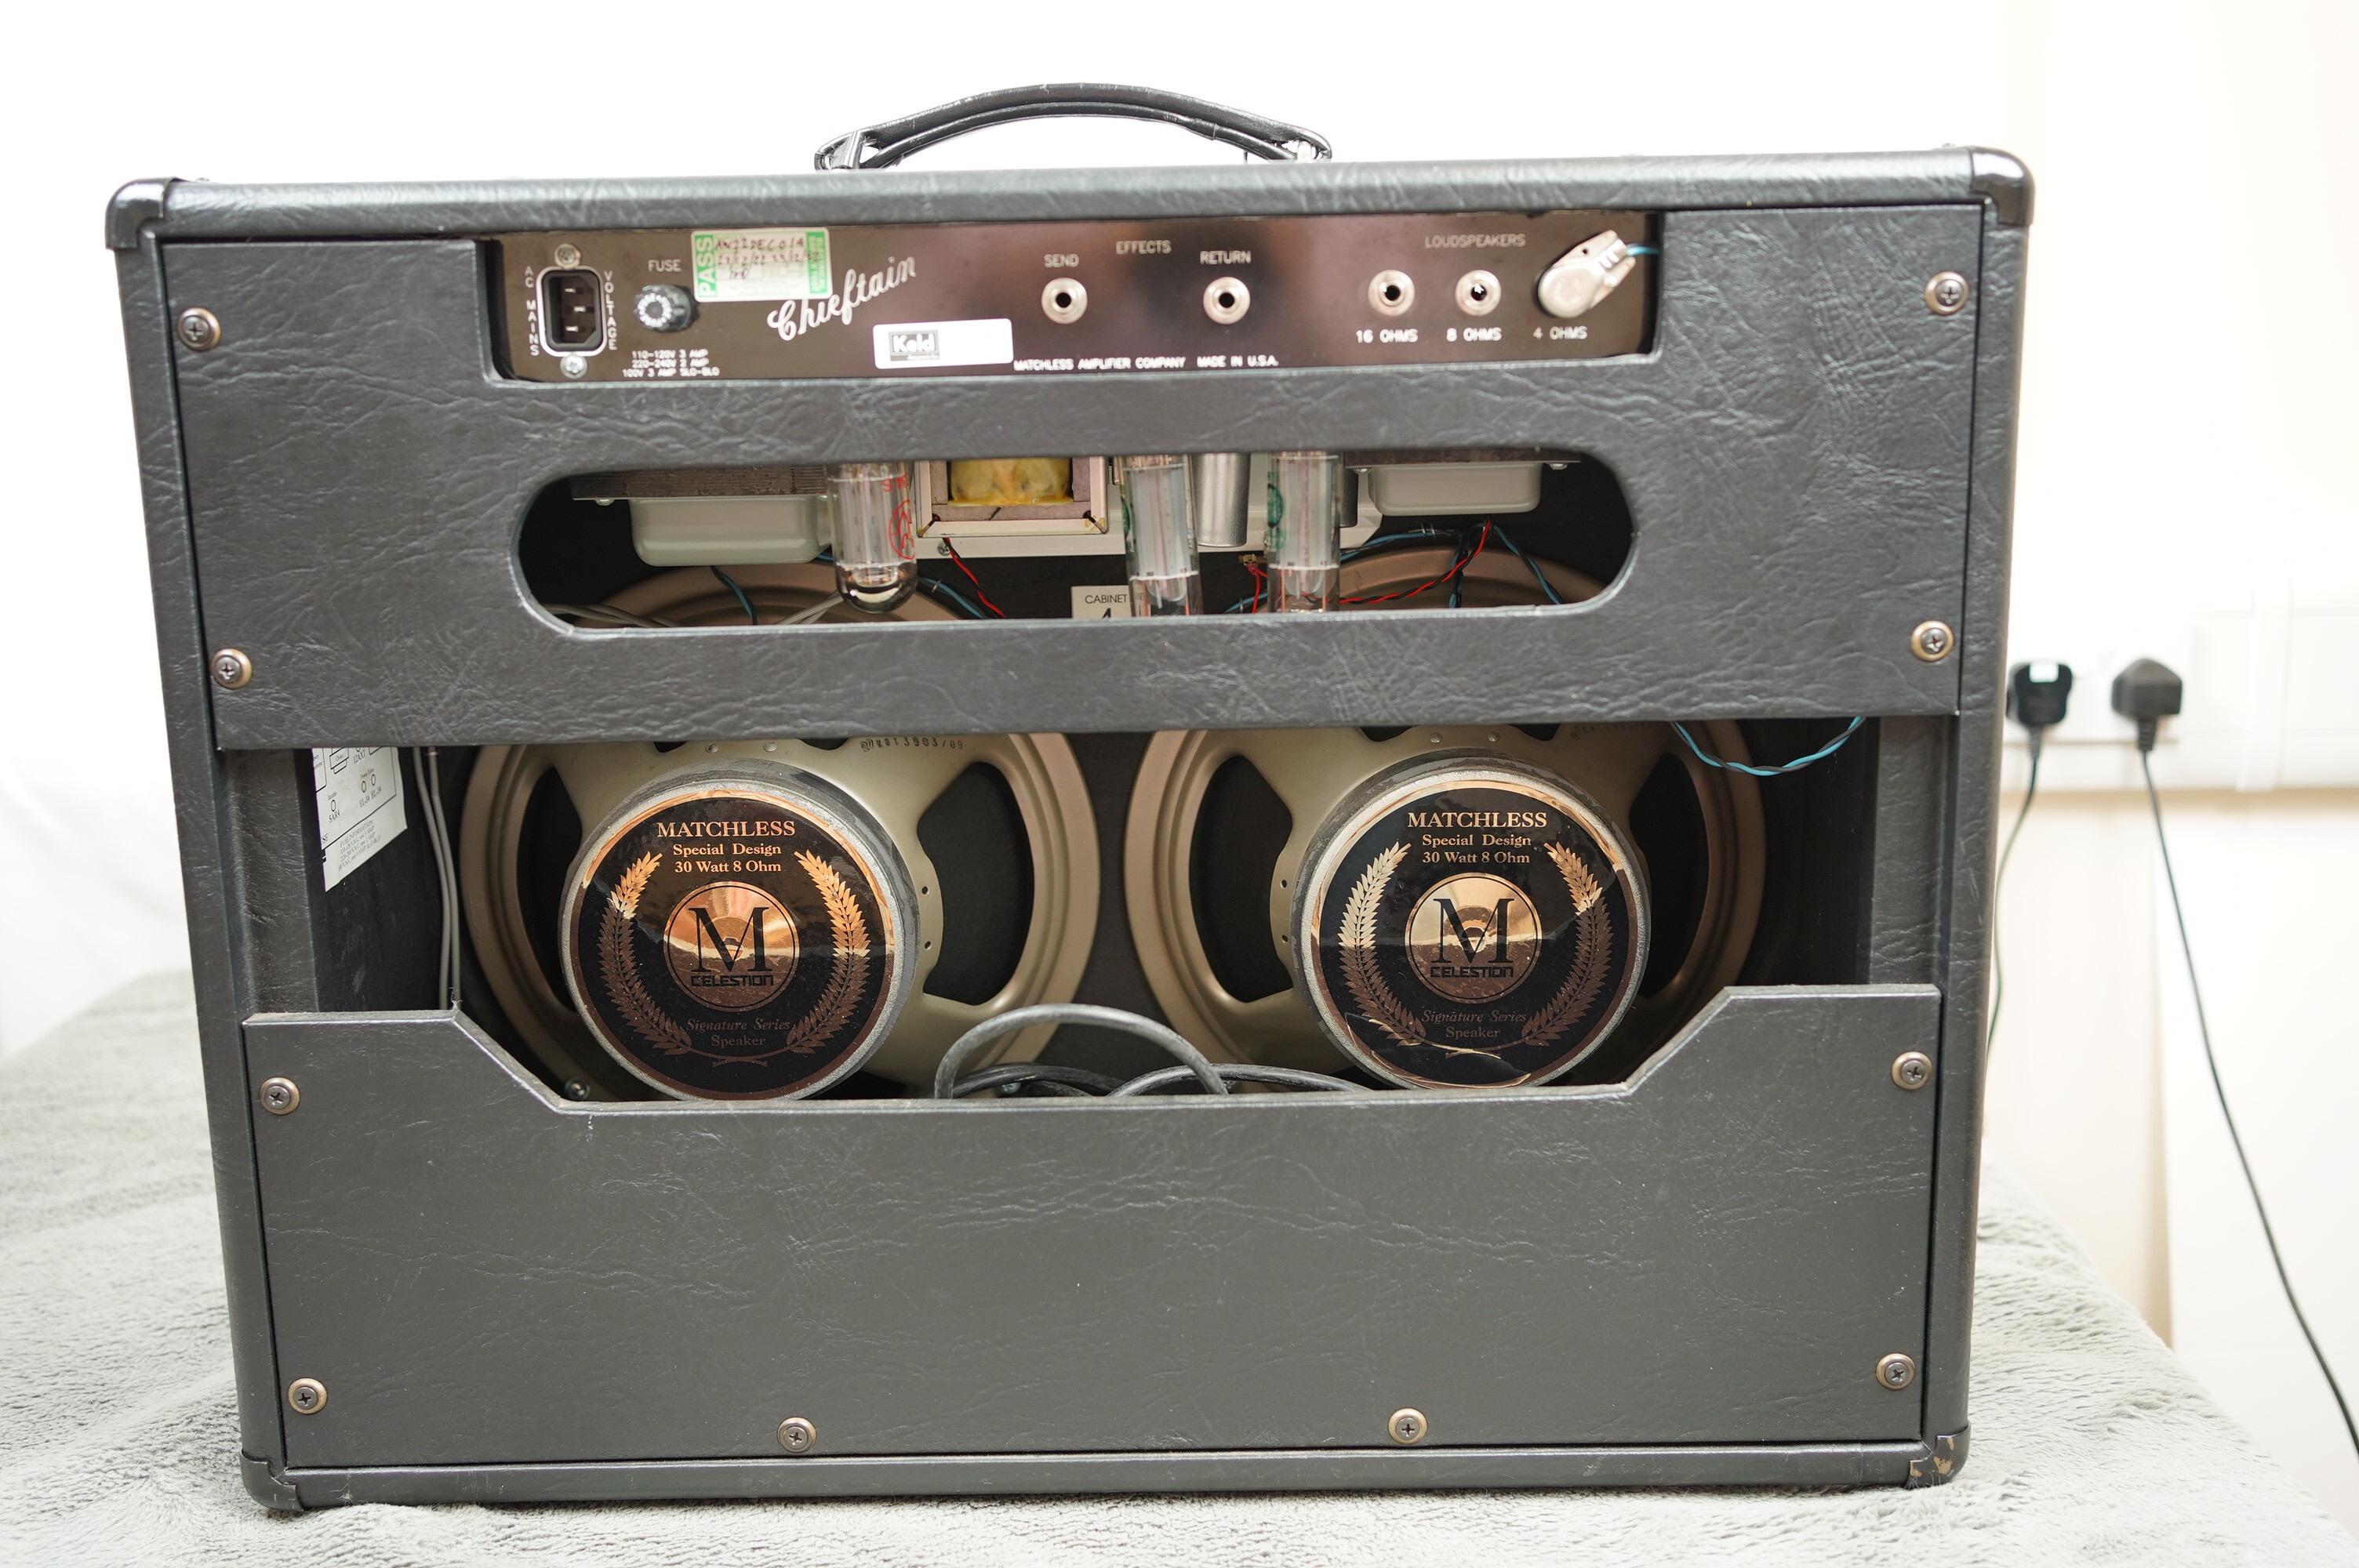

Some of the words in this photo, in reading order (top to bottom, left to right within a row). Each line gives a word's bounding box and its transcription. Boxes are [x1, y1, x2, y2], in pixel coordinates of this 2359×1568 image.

[1116, 240, 1172, 255] EFFECTS
[1425, 234, 1526, 249] LOUDSPEAKERS
[1044, 254, 1079, 267] SEND
[1200, 250, 1251, 264] RETURN
[648, 260, 682, 273] FUSE
[696, 237, 716, 296] PASS
[525, 266, 534, 289] AC
[767, 256, 916, 341] Chieftain
[603, 270, 618, 350] VOLTAGE
[525, 299, 540, 356] MAINS
[1446, 328, 1457, 341] 8
[1463, 327, 1502, 341] OHMS
[1532, 327, 1543, 339] 4
[1550, 326, 1587, 340] OHMS
[1356, 329, 1373, 343] 16
[1379, 328, 1418, 343] OHMS
[689, 349, 709, 358] AMP
[690, 358, 710, 367] AMP
[1014, 359, 1074, 371] MATCHLESS
[1078, 358, 1131, 370] AMPLIFIER
[1136, 357, 1186, 369] COMPANY
[1198, 356, 1226, 367] MADE
[1231, 355, 1243, 367] IN
[1248, 355, 1279, 366] U.S.A.
[657, 368, 677, 376] AMP
[1085, 594, 1128, 604] CABINET
[1408, 812, 1547, 828] MATCHLESS
[656, 820, 795, 837] MATCHLESS
[1422, 834, 1474, 847] Special
[1482, 834, 1532, 848] Design
[673, 844, 724, 857] Special
[732, 843, 782, 856] Design
[1422, 851, 1440, 863] 30
[1444, 851, 1478, 863] Watt
[1481, 851, 1490, 863] 8
[1494, 851, 1530, 863] Ohm
[674, 862, 692, 873] 30
[696, 861, 729, 873] Watt
[733, 860, 742, 873] 8
[745, 860, 782, 872] Ohm
[1433, 898, 1514, 964] M
[689, 906, 773, 972] M
[1430, 966, 1514, 978] CELESTION
[691, 975, 774, 987] CELESTION
[1422, 1011, 1483, 1024] Signature
[1490, 1010, 1528, 1022] Series
[686, 1019, 747, 1033] Signature
[753, 1018, 791, 1031] Series
[1445, 1026, 1501, 1040] Speaker
[711, 1035, 766, 1049] Speaker
